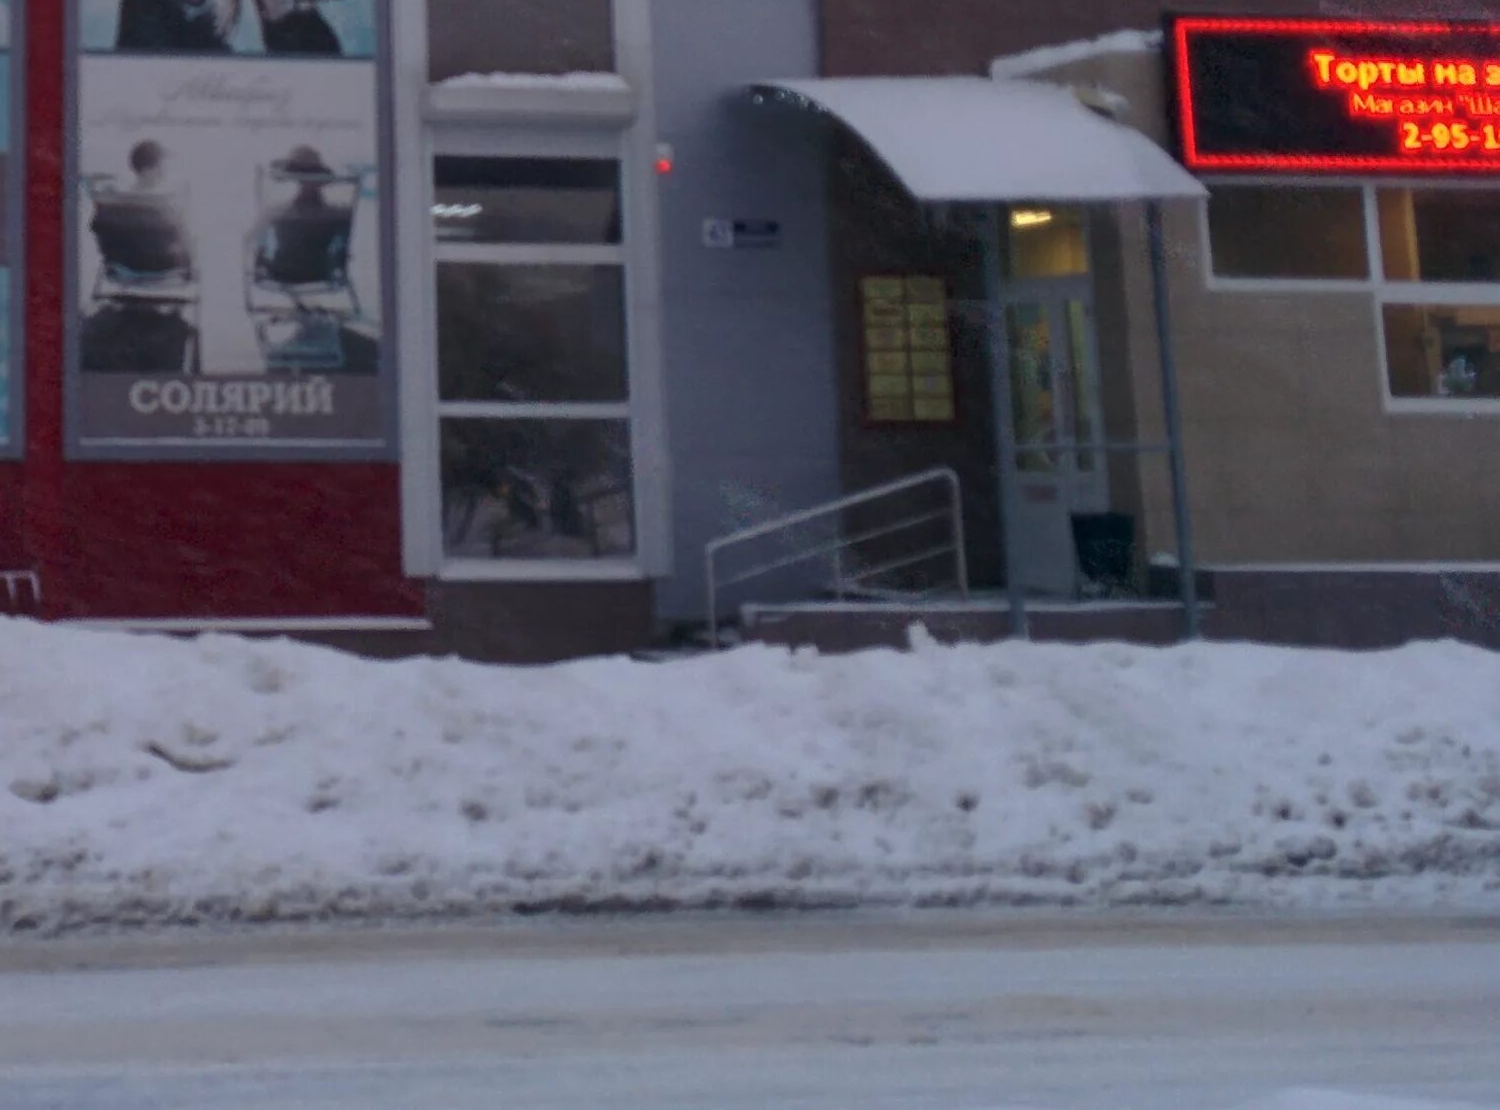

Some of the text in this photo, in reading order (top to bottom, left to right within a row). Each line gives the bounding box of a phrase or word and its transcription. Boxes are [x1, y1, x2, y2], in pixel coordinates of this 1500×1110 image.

[1313, 53, 1425, 90] Торты
[1434, 61, 1477, 86] на
[128, 376, 336, 415] СОЛЯРИЙ
